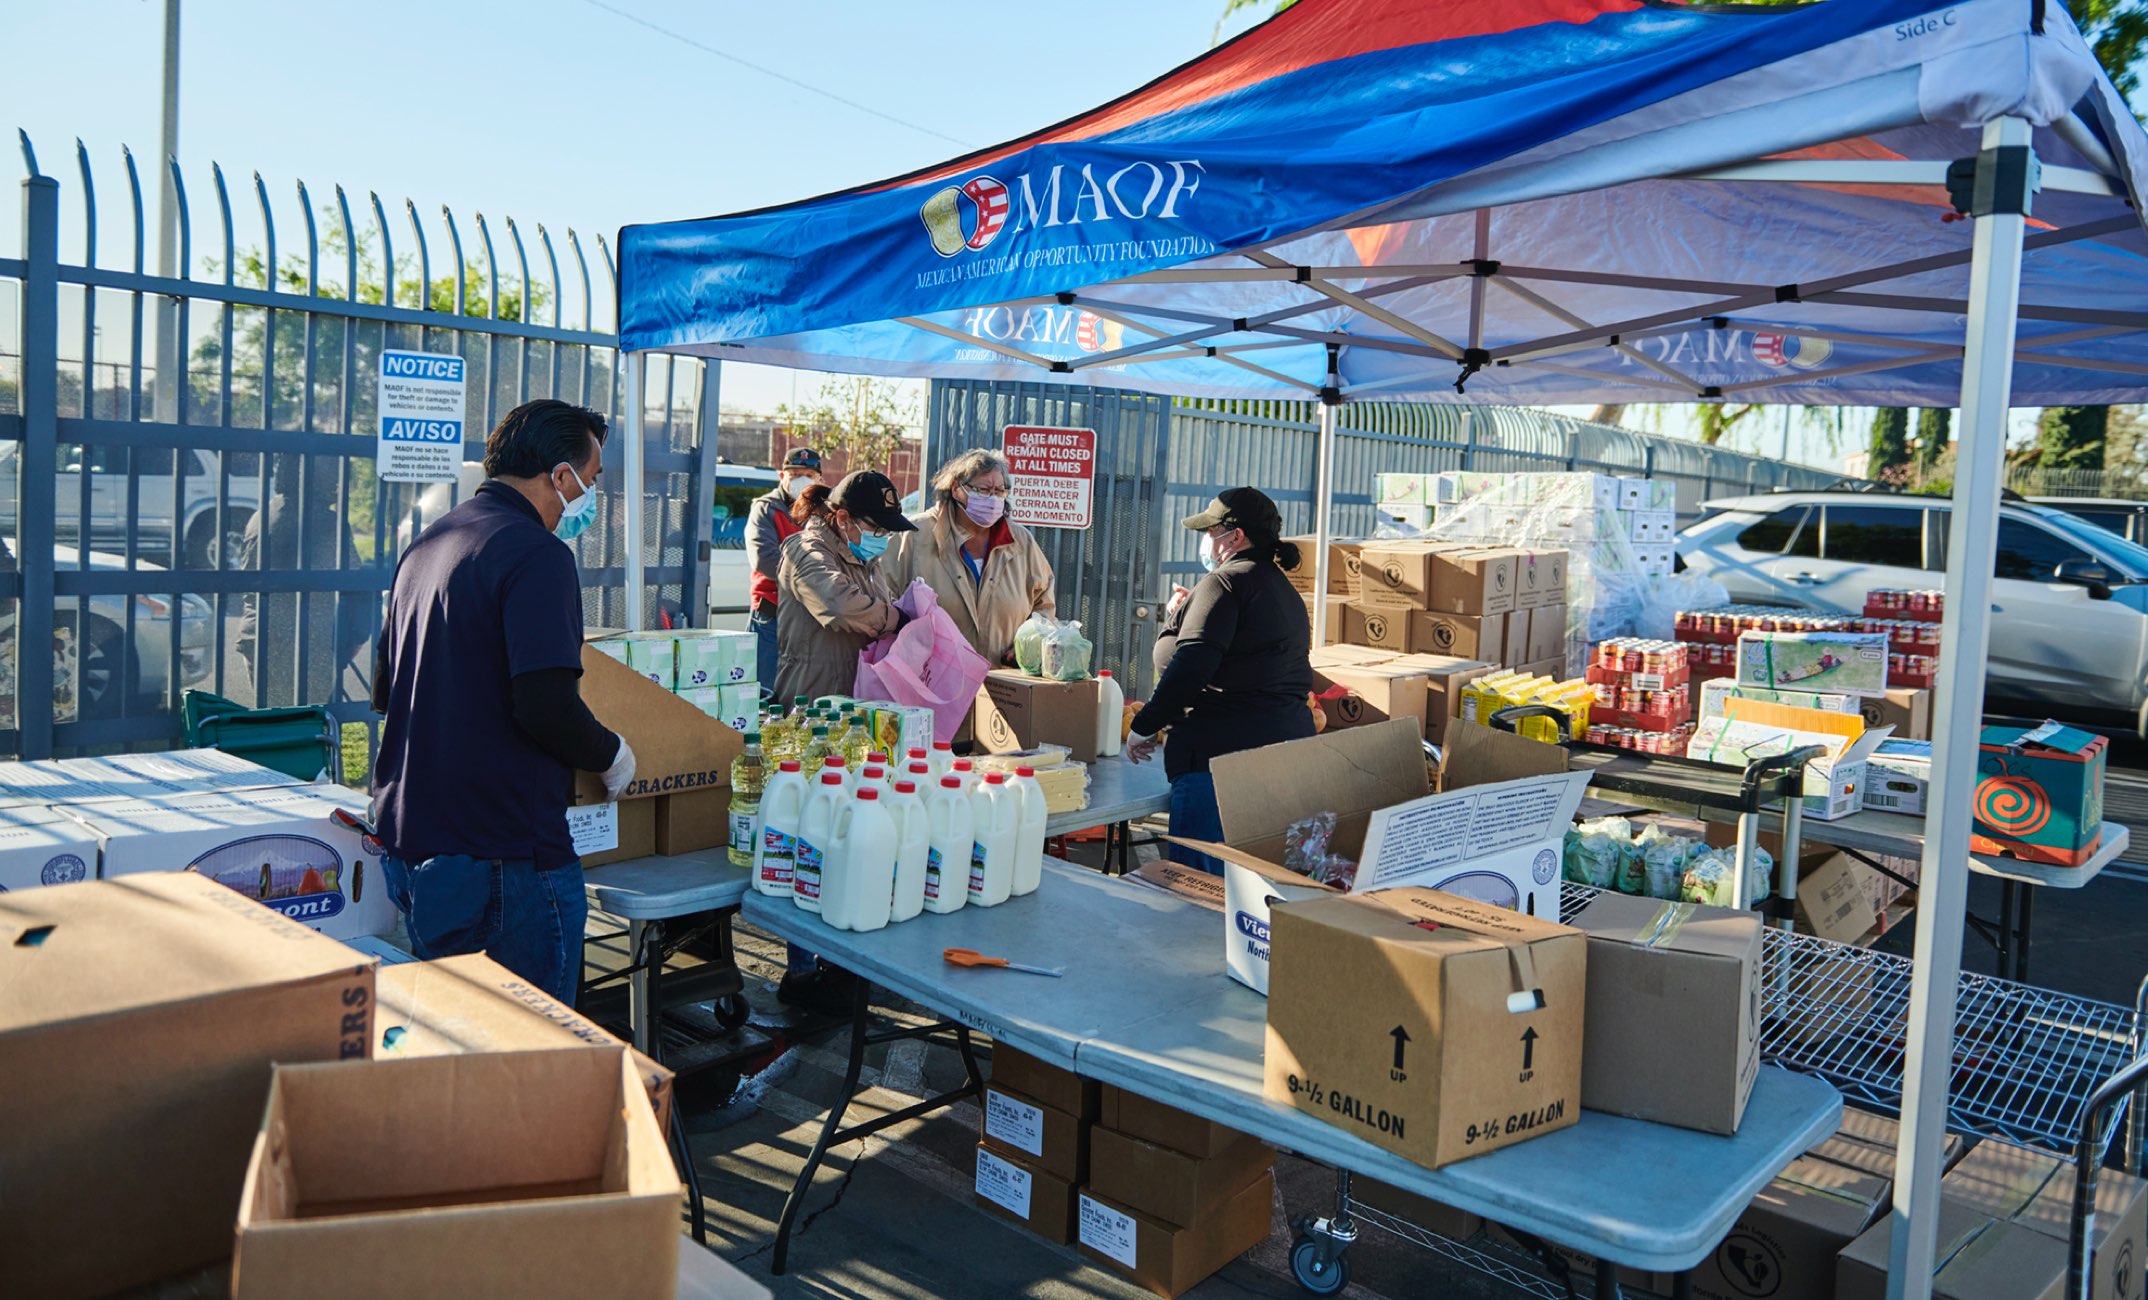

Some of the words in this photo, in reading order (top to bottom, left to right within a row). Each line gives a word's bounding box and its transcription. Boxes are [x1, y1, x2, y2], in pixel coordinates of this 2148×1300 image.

[1895, 18, 1938, 42] Side
[1943, 11, 1957, 27] C
[1012, 160, 1206, 233] MAOF
[915, 265, 963, 290] MEXICAN
[964, 253, 1019, 279] AMERICAN
[1024, 243, 1120, 269] OPPORTUNITY
[1121, 236, 1215, 261] FOUNDATION
[386, 356, 461, 378] NOTICE
[425, 388, 461, 396] responsible
[389, 402, 416, 410] vehicles
[425, 396, 450, 404] damage
[388, 420, 456, 441] AVISO
[1020, 432, 1046, 444] GATE
[1048, 434, 1079, 446] MUST
[1007, 446, 1047, 458] REMAIN
[1050, 448, 1090, 460] CLOSED
[1014, 459, 1028, 470] AT
[1028, 460, 1047, 472] ALL
[1048, 461, 1081, 474] TIMES
[1014, 477, 1050, 488] PUERTA
[1053, 479, 1079, 490] DEBE
[1013, 488, 1079, 500] PERMANECER
[1015, 499, 1060, 510] CERRADA
[1063, 502, 1076, 510] EN
[1034, 511, 1083, 522] MOMENTO
[625, 770, 718, 796] CRACKERS
[1160, 868, 1186, 878] KEEP
[500, 980, 612, 1045] CRACKERS
[1390, 1069, 1407, 1084] UP
[1519, 1070, 1534, 1084] UP
[1329, 1090, 1404, 1140] GALLON
[1505, 1098, 1565, 1135] GALLON
